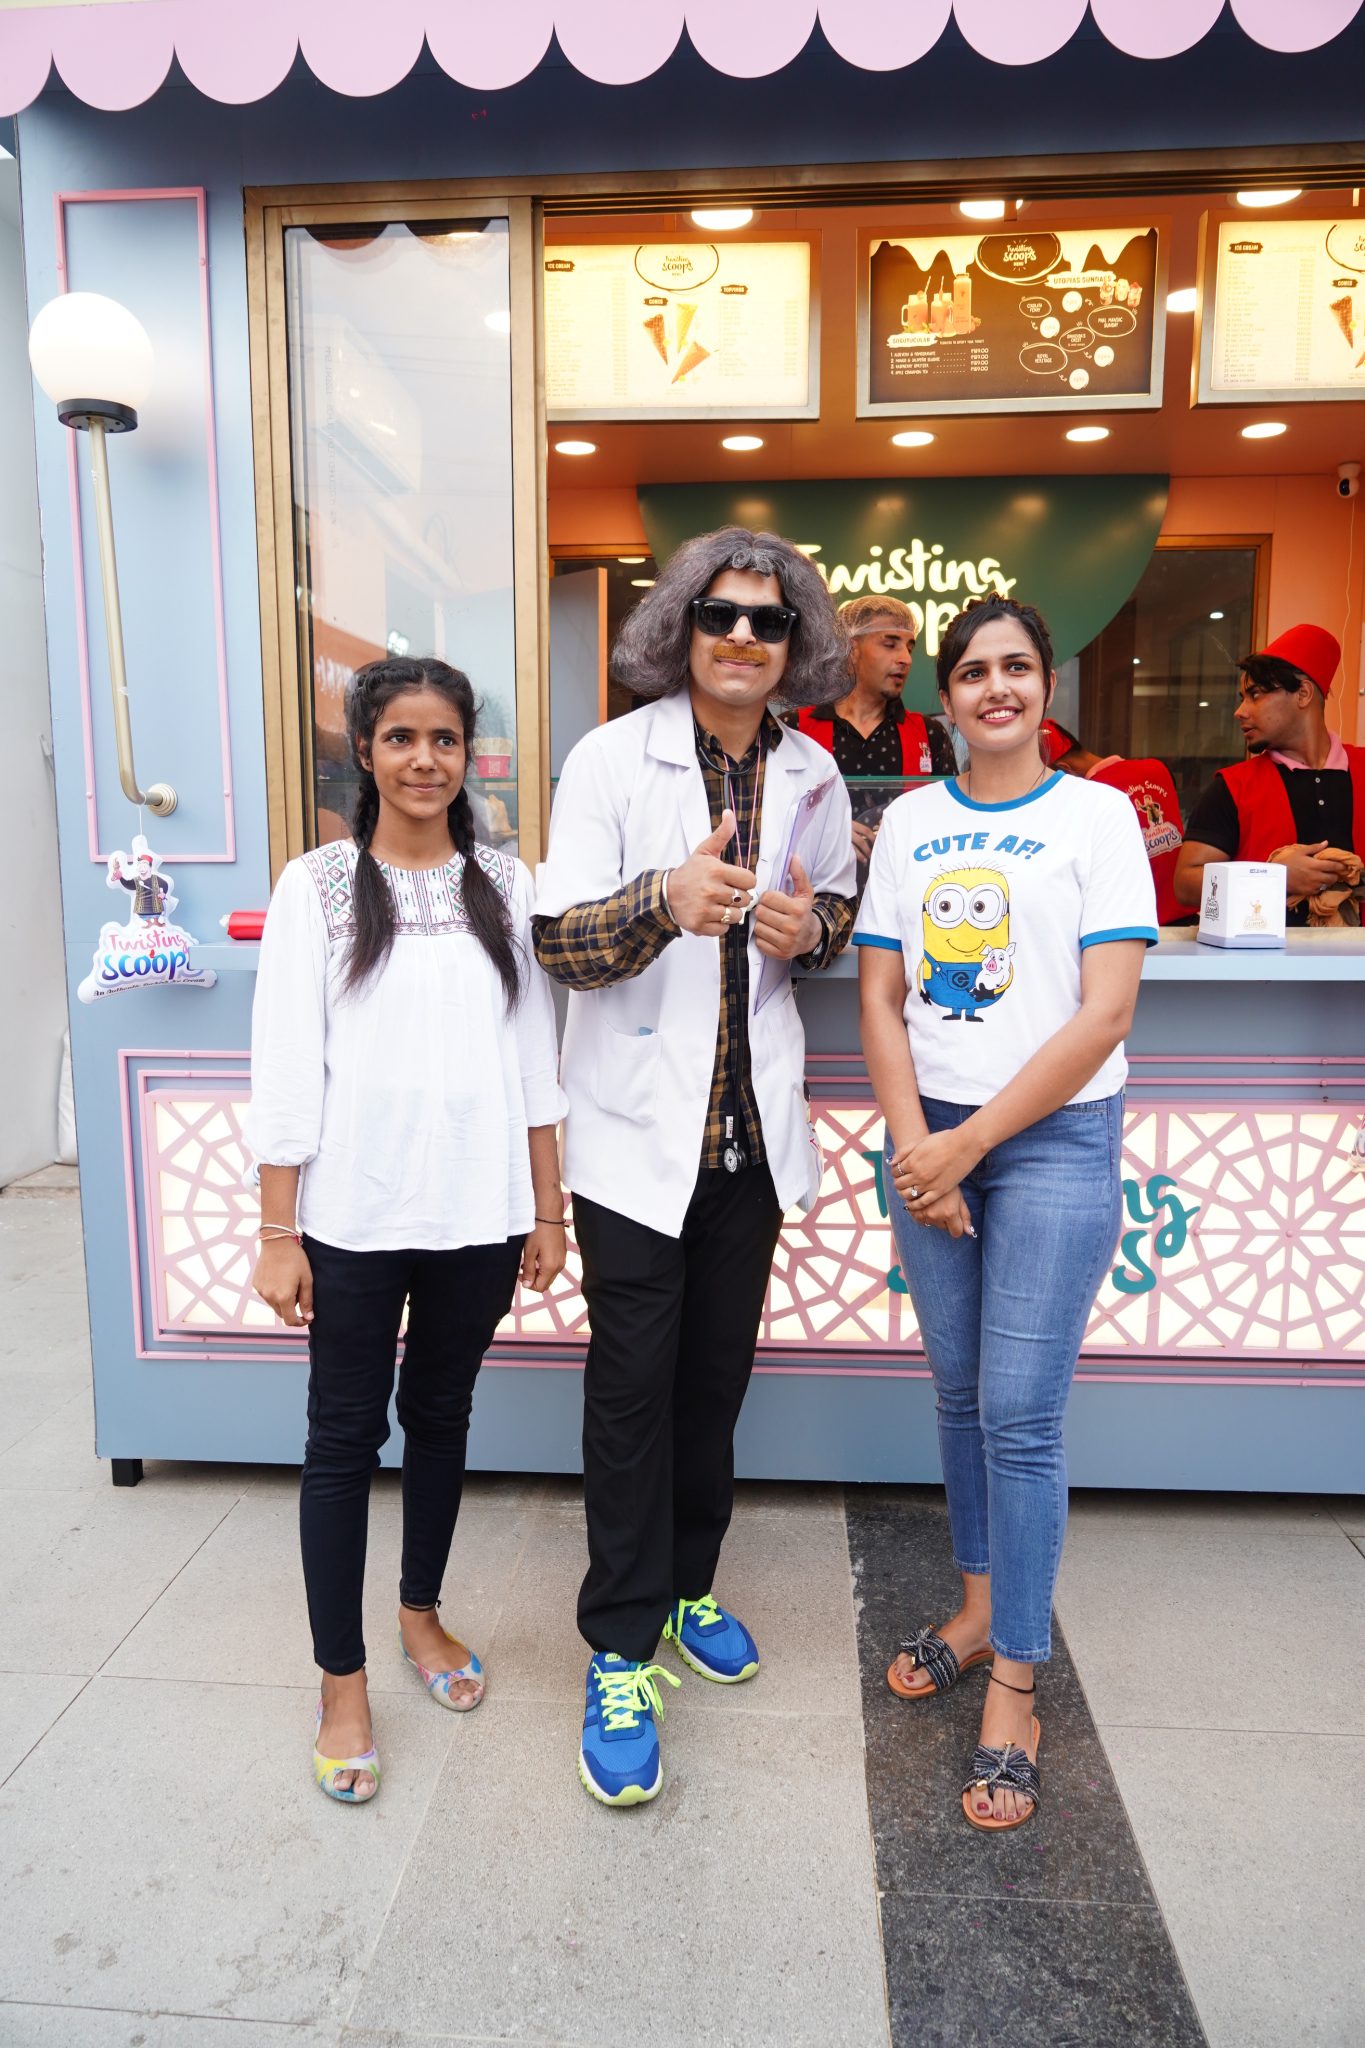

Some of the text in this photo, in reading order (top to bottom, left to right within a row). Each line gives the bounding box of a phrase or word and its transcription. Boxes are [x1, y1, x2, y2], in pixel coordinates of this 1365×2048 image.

[913, 832, 1047, 862] CUTE AF!
[109, 930, 189, 955] Twisting
